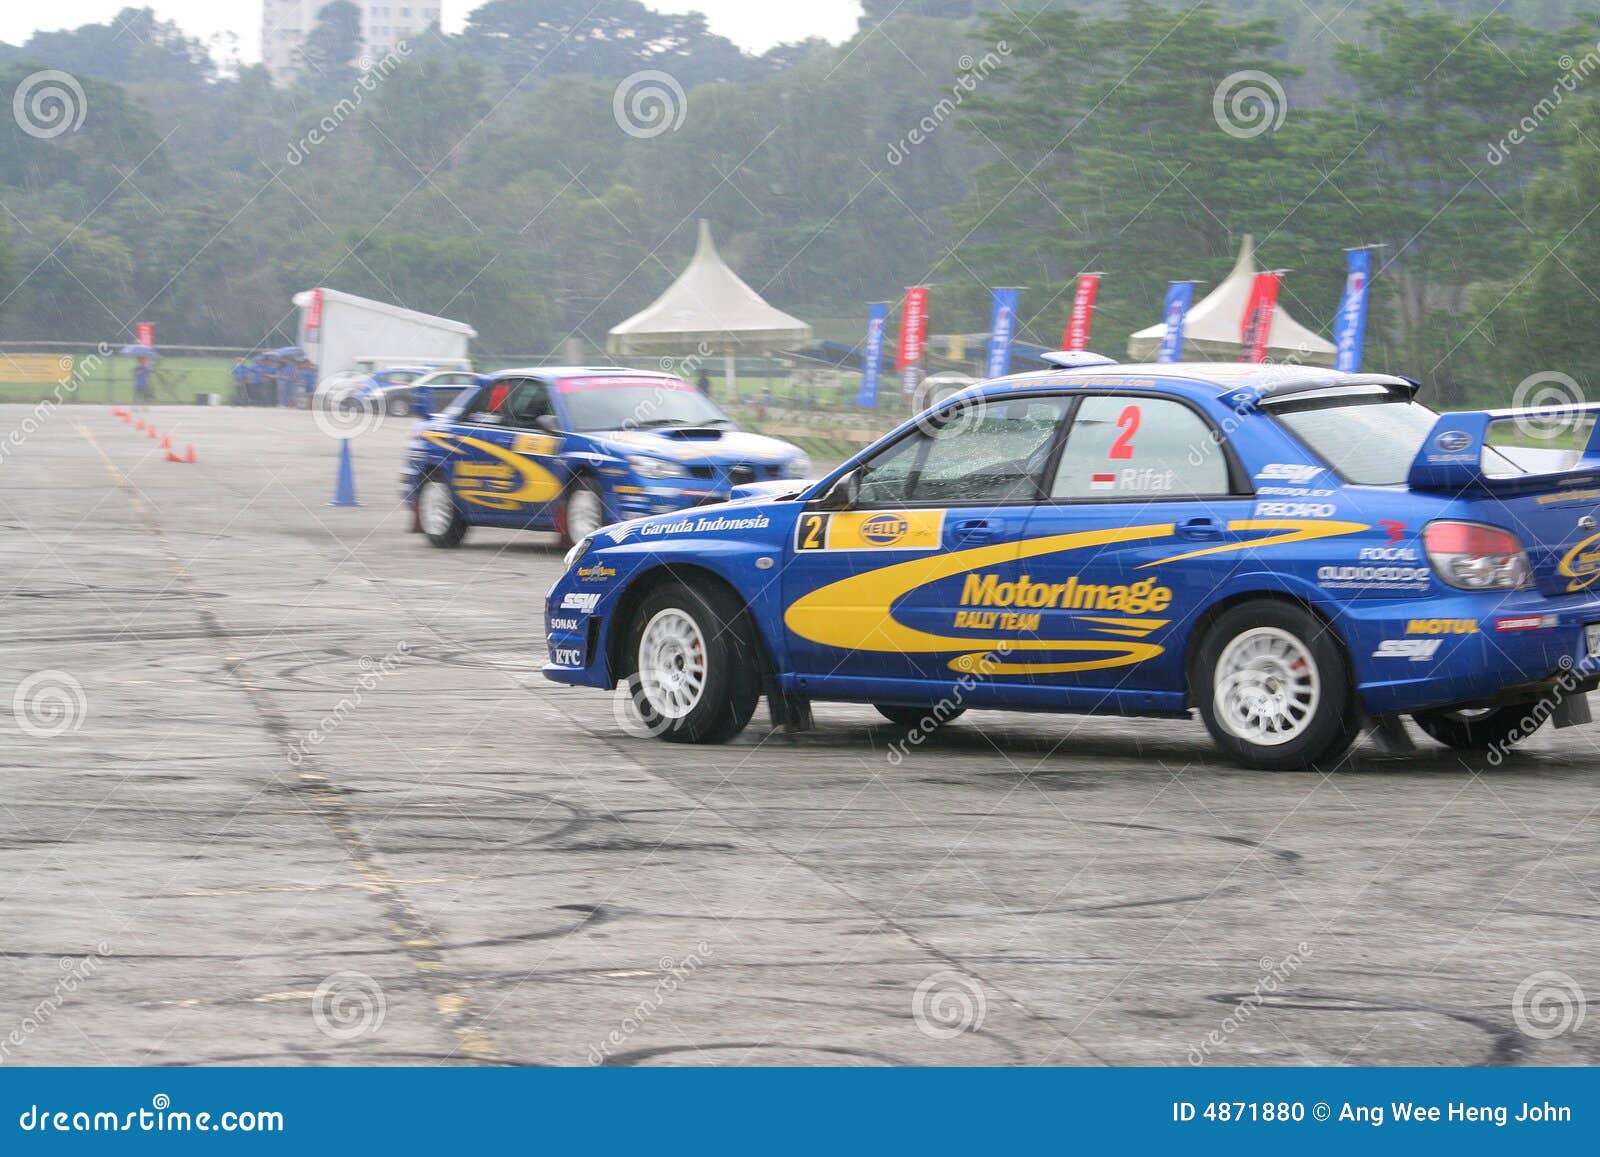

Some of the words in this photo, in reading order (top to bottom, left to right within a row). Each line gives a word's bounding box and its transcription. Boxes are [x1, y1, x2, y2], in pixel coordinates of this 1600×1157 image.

[1108, 404, 1142, 459] 2
[1119, 468, 1175, 491] Rifat
[1254, 502, 1337, 517] RECARO
[640, 518, 695, 536] Garuda
[695, 514, 770, 532] Indonesia
[802, 515, 823, 549] 2
[863, 520, 910, 535] HELLA
[1359, 548, 1418, 561] FOCAL
[560, 593, 602, 609] SSW
[551, 618, 578, 630] SONAX
[953, 611, 997, 630] RALLY
[999, 612, 1042, 631] TEAM
[1405, 619, 1480, 635] MOTUL
[555, 649, 581, 666] KTC
